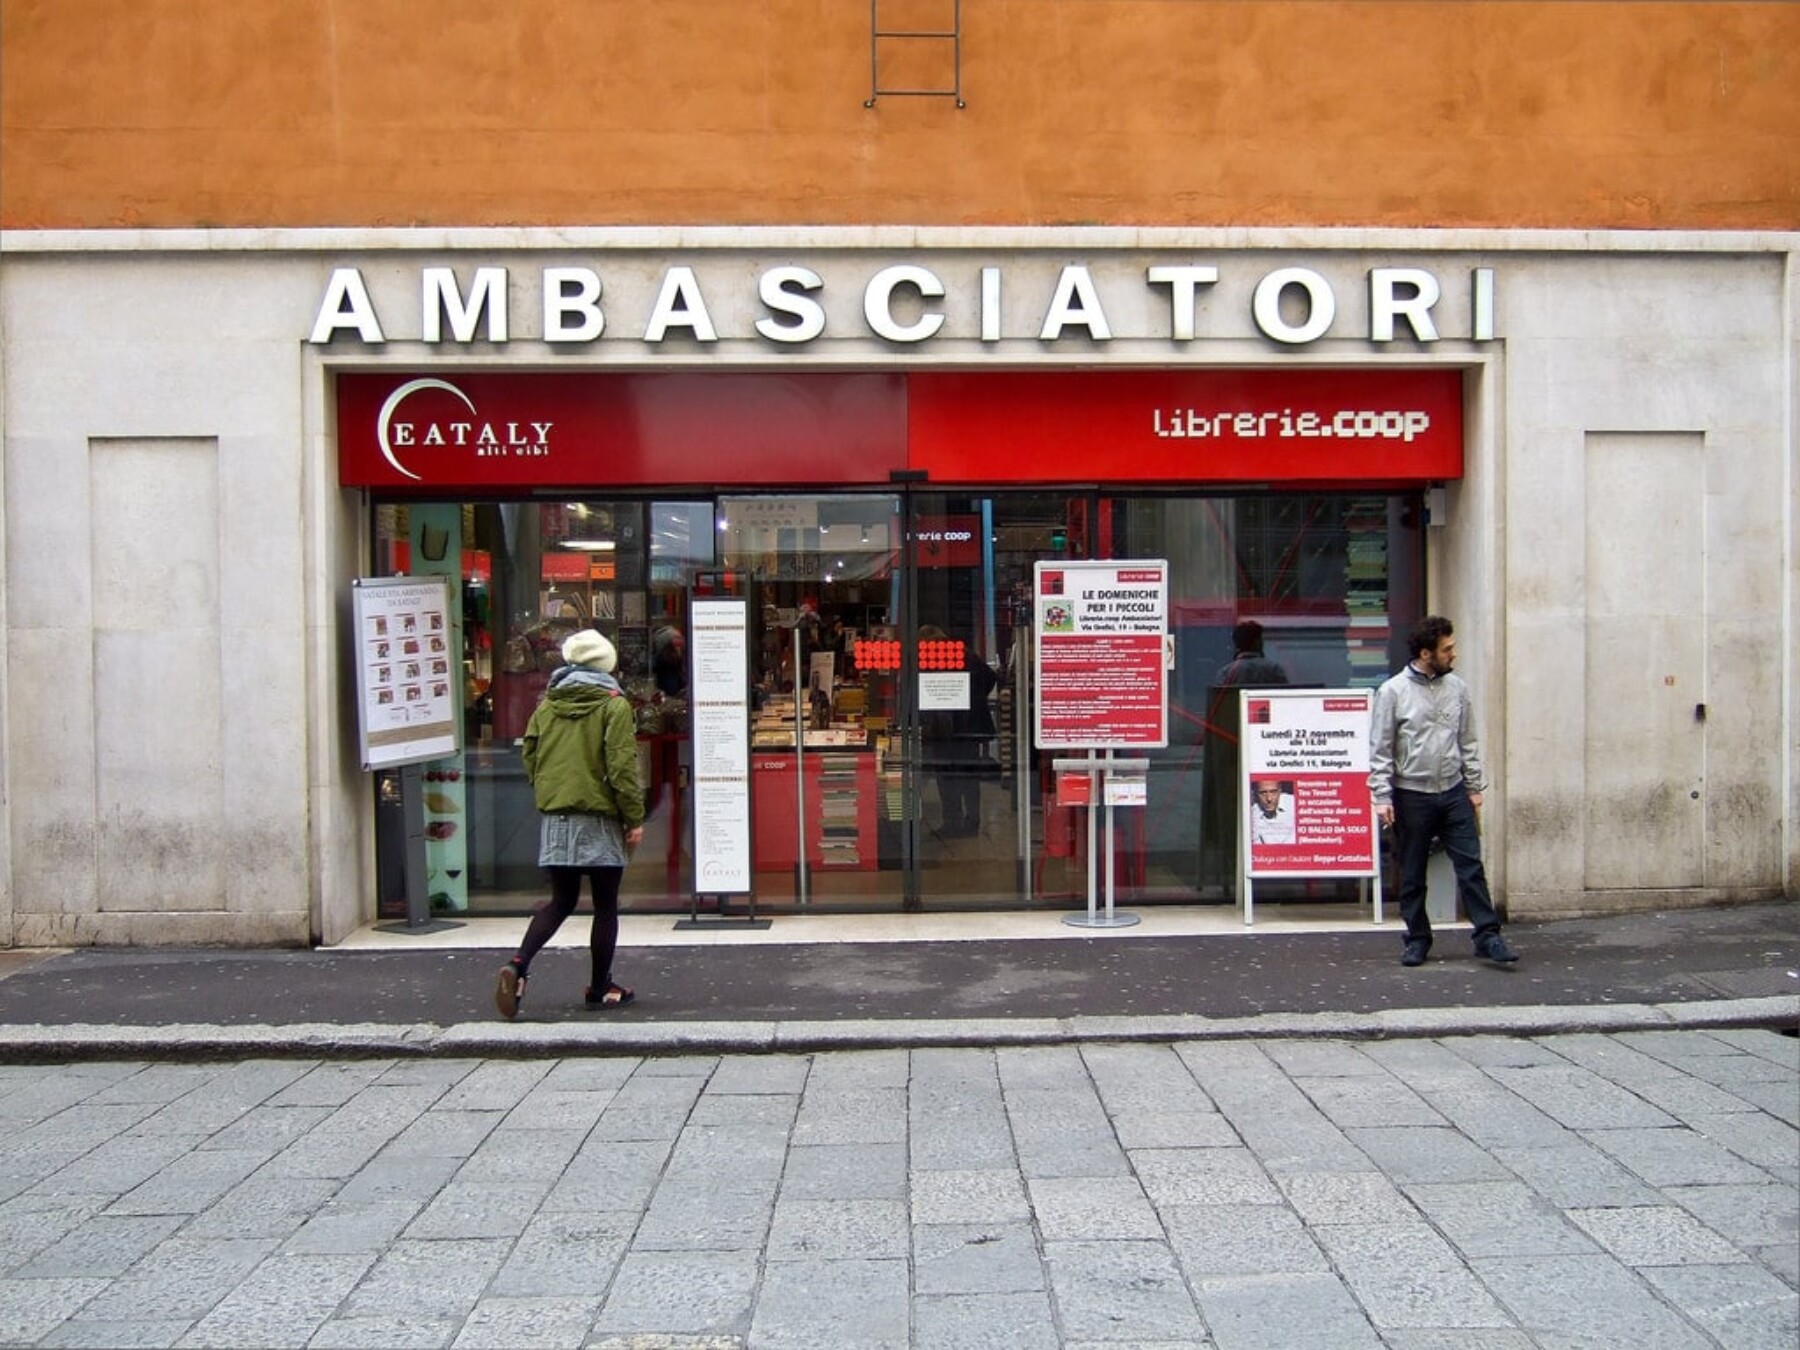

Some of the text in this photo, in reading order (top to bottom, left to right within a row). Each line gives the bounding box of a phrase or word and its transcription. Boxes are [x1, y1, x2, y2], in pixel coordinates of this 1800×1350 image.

[309, 265, 1495, 345] AMBASCIATORI
[393, 422, 554, 446] EATALY
[477, 445, 549, 456] alti cibi
[1082, 590, 1159, 600] LE DOMENICHE
[1087, 603, 1106, 612] PER
[1115, 603, 1155, 612] PICCOLI
[1295, 729, 1307, 738] 22
[1309, 729, 1355, 738] novembre
